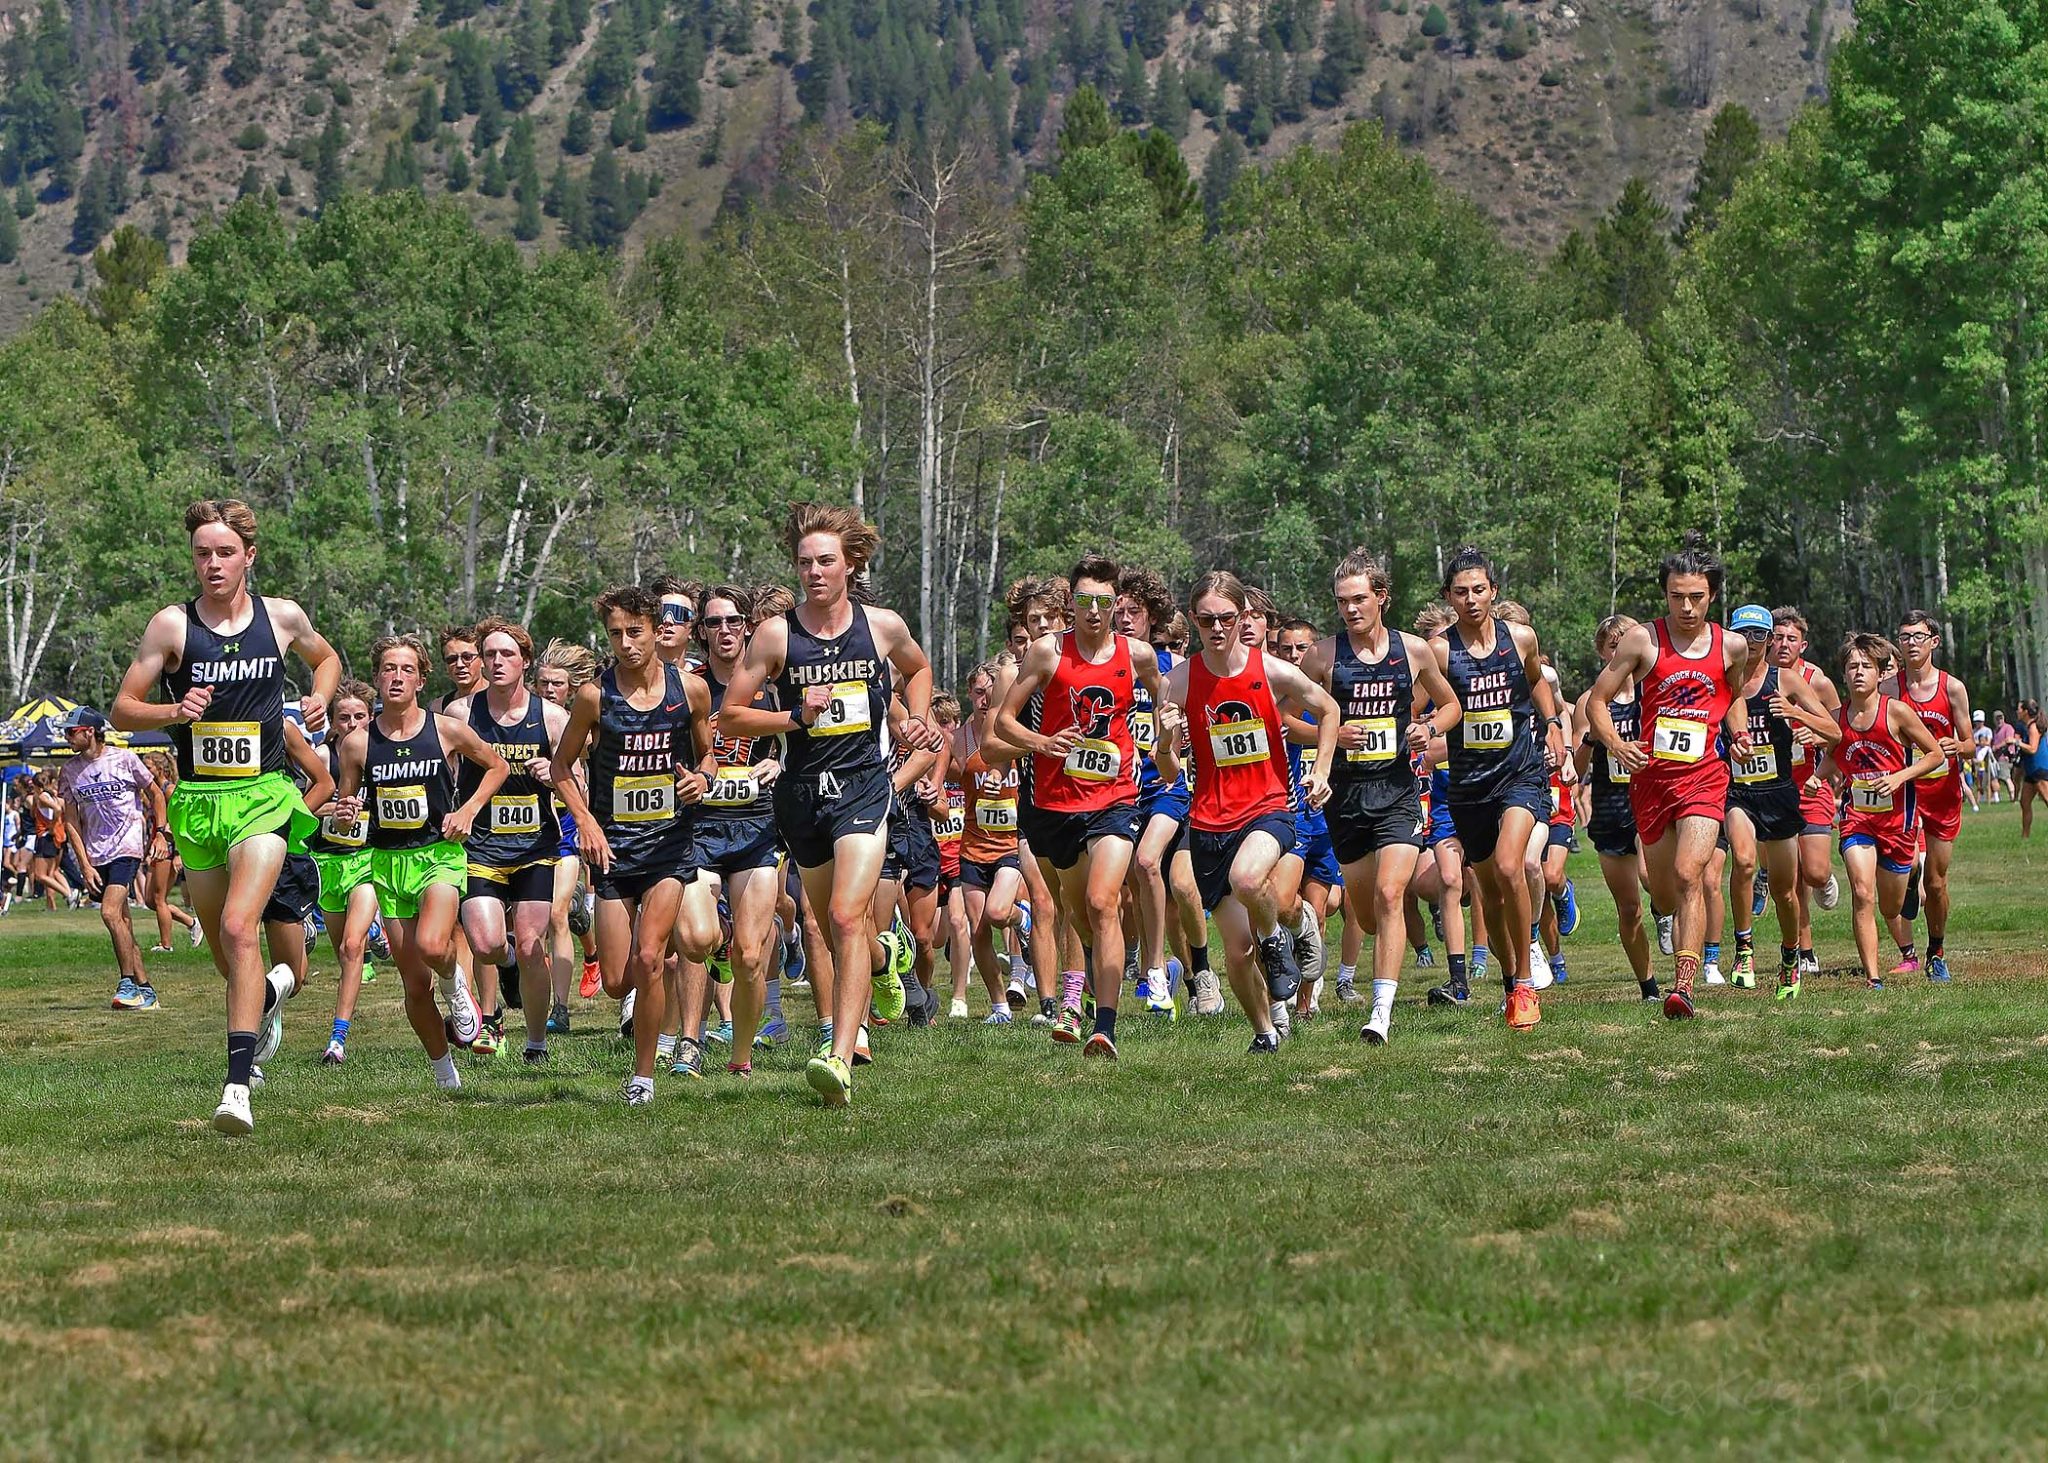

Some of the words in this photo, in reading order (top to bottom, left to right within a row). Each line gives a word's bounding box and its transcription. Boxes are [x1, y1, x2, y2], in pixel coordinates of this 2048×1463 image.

[191, 656, 278, 683] SUMMIT
[788, 659, 876, 685] HUSKIES
[1353, 681, 1394, 698] EAGLE
[1470, 672, 1507, 692] EAGLE
[1658, 670, 1690, 692] CAPROCK
[1691, 670, 1716, 696] ACADEMY
[1348, 700, 1397, 716] VALLEY
[1467, 689, 1512, 710] VALLEY
[1924, 710, 1950, 727] ACADEMY
[624, 732, 672, 751] EAGLE
[1471, 722, 1504, 741] 102
[1669, 730, 1691, 753] 75
[202, 737, 251, 764] 886
[1223, 732, 1258, 756] 181
[372, 759, 442, 782] SUMMIT
[618, 752, 673, 771] VALLEY
[1076, 749, 1112, 773] 183
[77, 783, 121, 799] MEAD
[624, 788, 664, 812] 103
[711, 779, 751, 800] 205
[381, 799, 421, 820] 890
[498, 806, 533, 825] 840
[983, 809, 1009, 825] 775
[935, 817, 963, 835] 803
